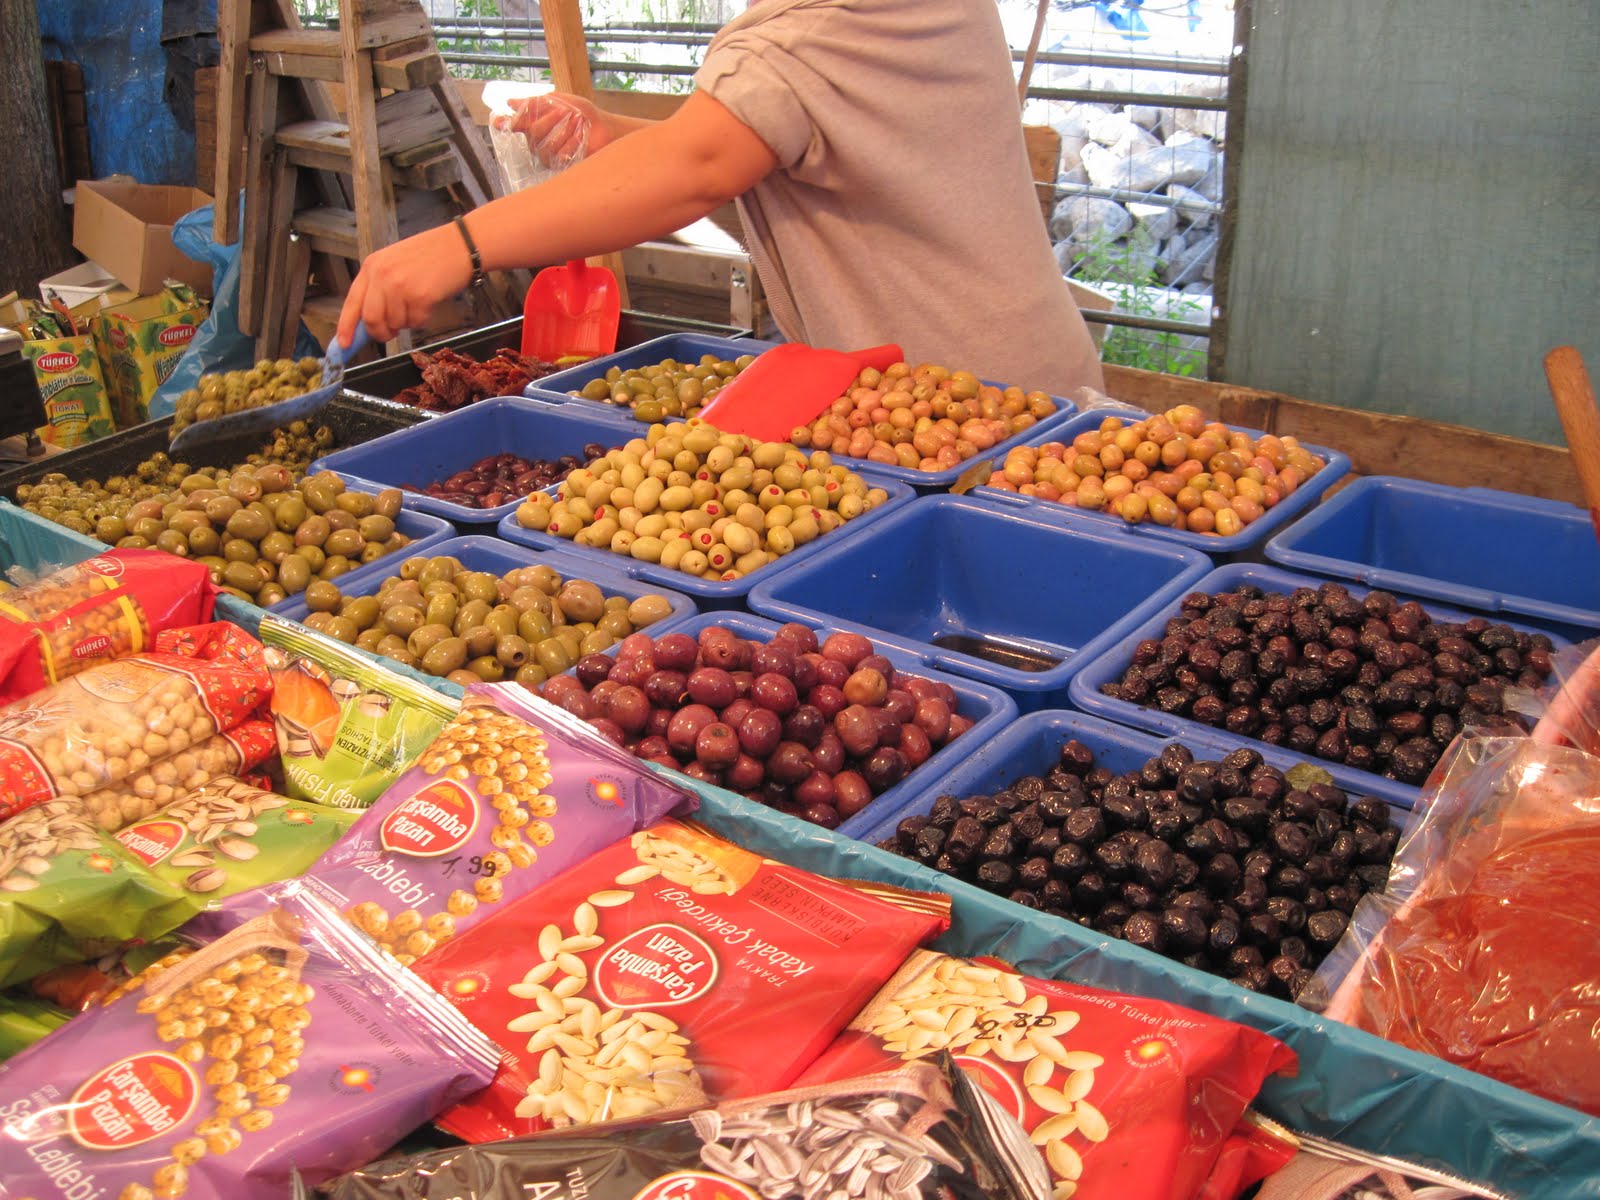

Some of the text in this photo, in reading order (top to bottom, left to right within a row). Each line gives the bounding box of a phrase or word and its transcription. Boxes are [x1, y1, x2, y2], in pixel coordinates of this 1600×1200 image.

[162, 327, 194, 342] TÜRKEL
[40, 355, 75, 368] TÜRKEL
[54, 403, 80, 413] TOKAT
[74, 637, 108, 656] TÜRKEL
[387, 815, 436, 847] Pazarı
[398, 796, 467, 839] Çarşamba
[760, 875, 799, 899] SEED
[653, 887, 815, 978] Kabak Çekirdeği
[645, 931, 705, 975] Pazarı
[609, 947, 696, 1000] Çarşamba
[735, 957, 788, 988] TRAKYA
[1120, 1004, 1162, 1026] Türkel
[102, 1061, 175, 1132] Çarşamba
